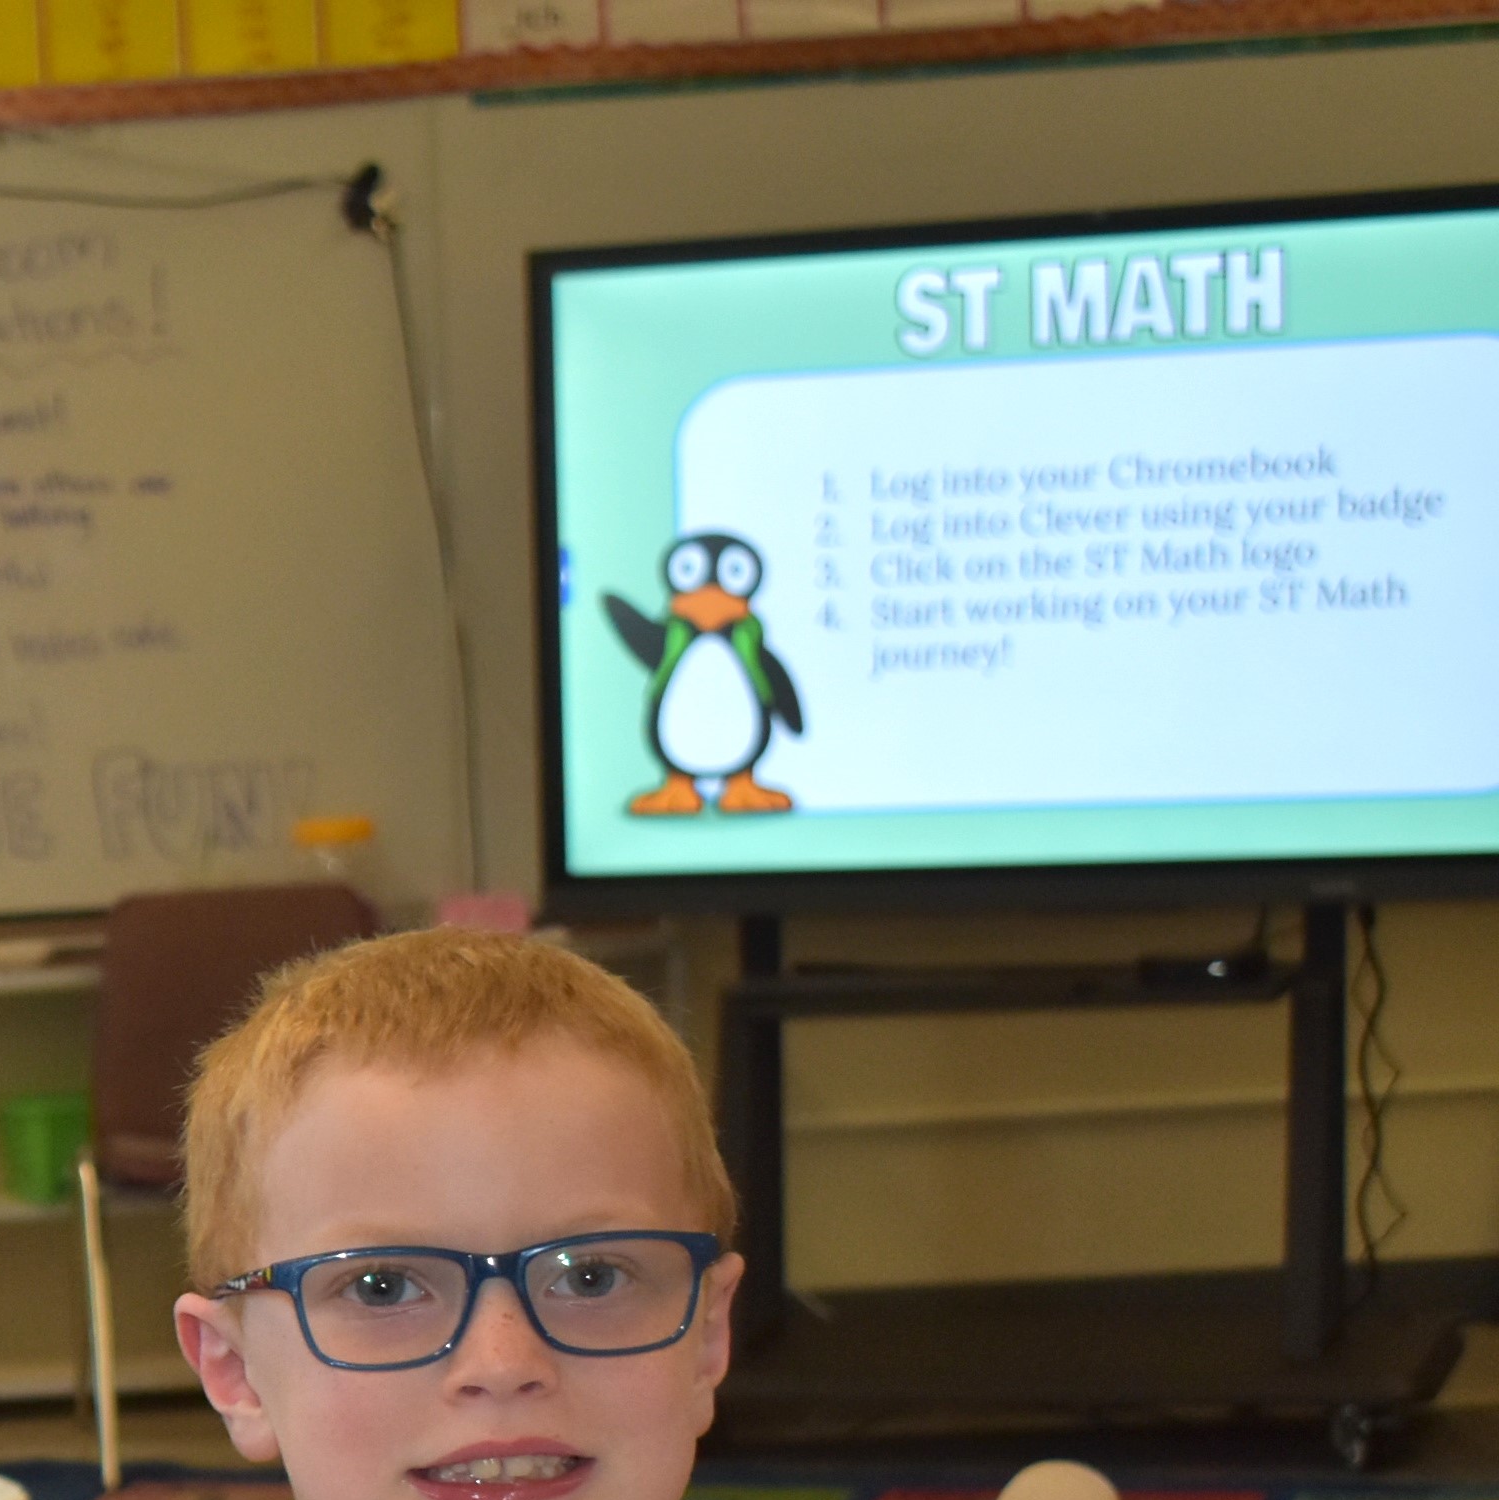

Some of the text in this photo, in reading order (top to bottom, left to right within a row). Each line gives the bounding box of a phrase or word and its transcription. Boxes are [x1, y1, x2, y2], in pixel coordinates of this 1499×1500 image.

[897, 246, 1285, 356] ST MATH
[871, 444, 1337, 507] Log into your Chromebook
[871, 484, 1446, 551] Log into Clever using your badge
[870, 535, 1317, 588] Click on the ST Math logo
[871, 571, 1408, 631] Start working on your ST Math
